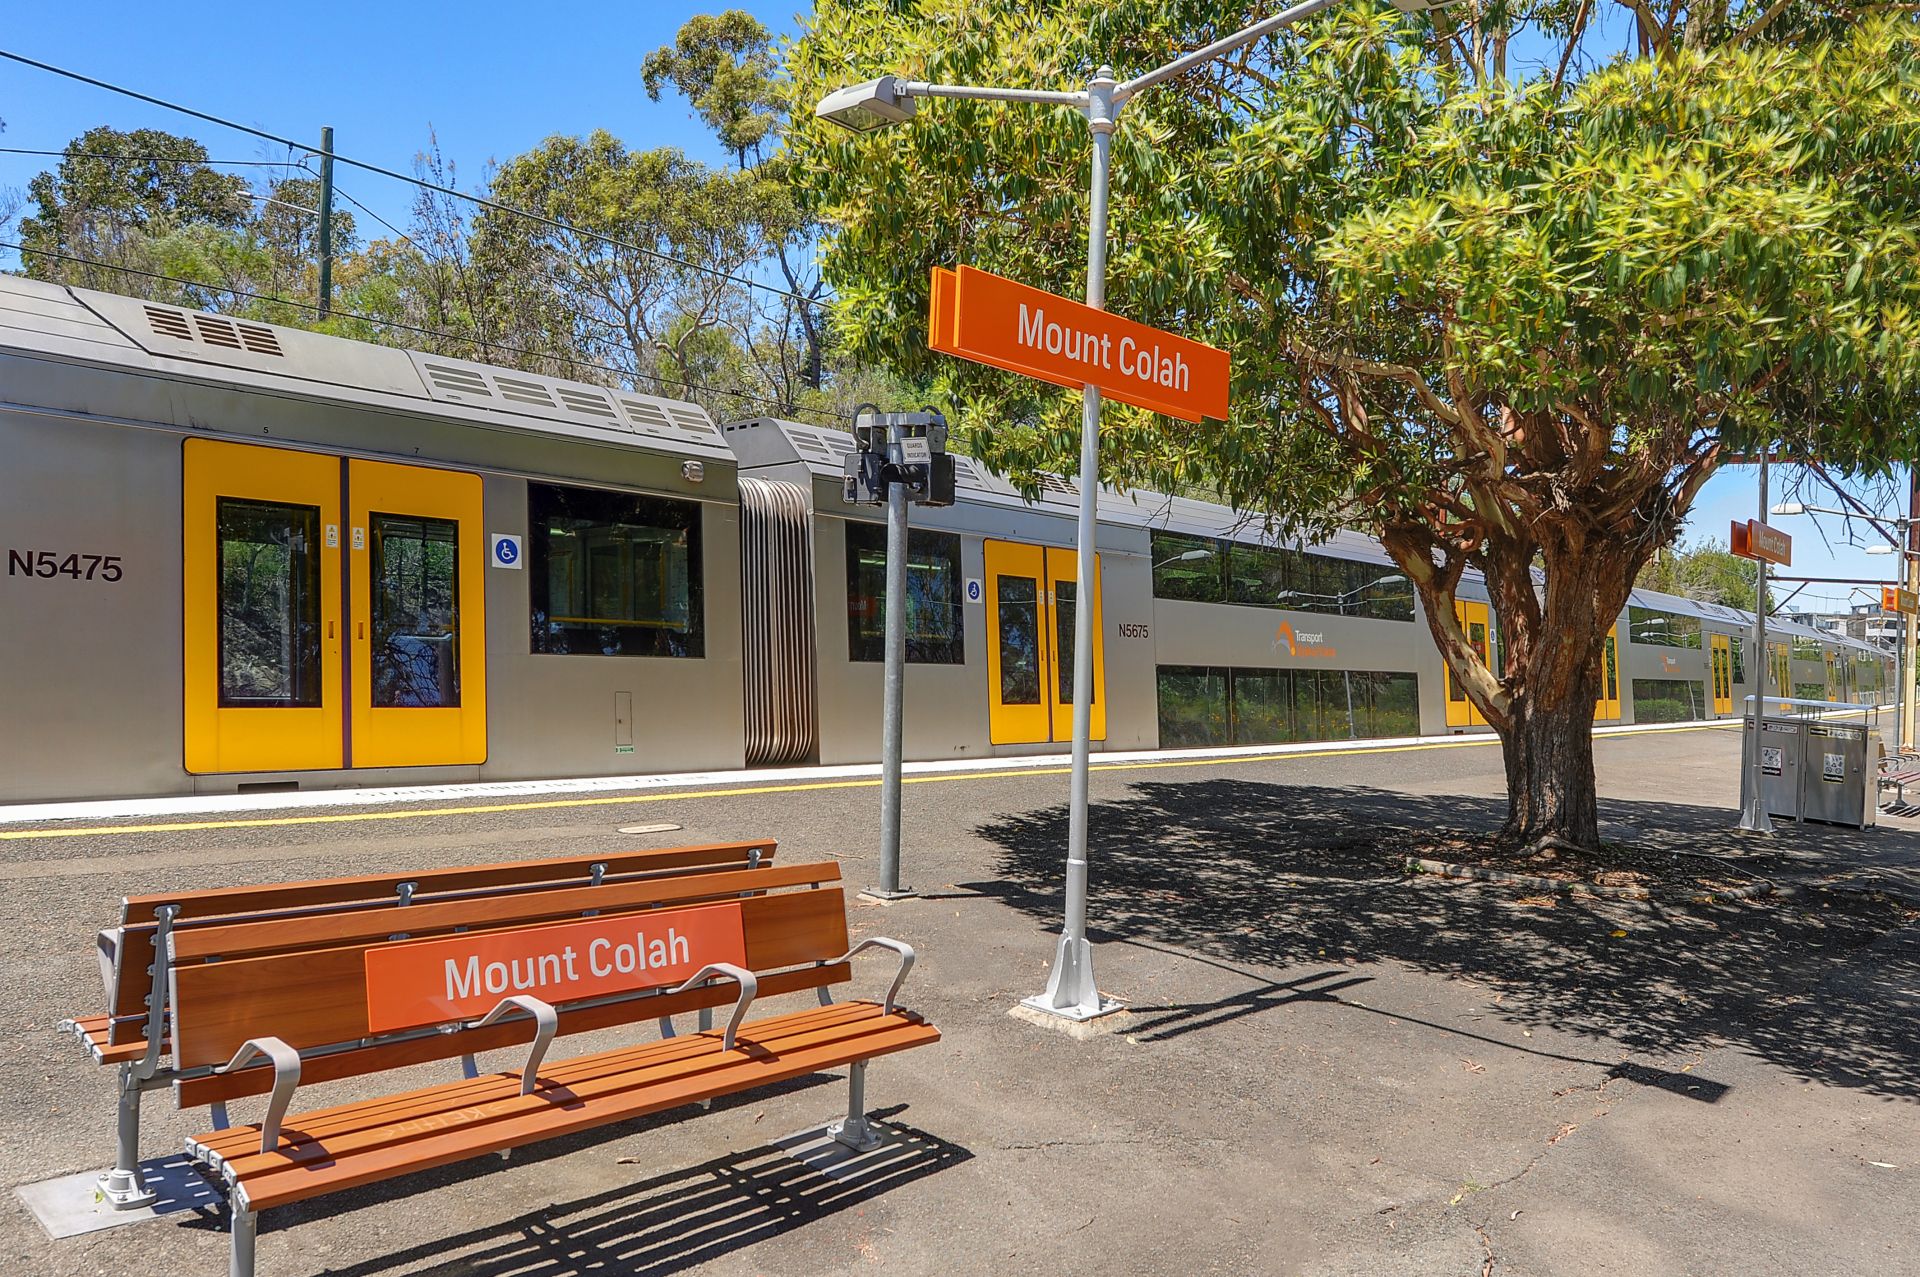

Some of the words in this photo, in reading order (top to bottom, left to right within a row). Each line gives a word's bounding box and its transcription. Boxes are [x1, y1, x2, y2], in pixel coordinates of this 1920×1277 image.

[1018, 303, 1112, 370] Mount
[1119, 336, 1190, 392] Colah
[8, 549, 123, 582] N5475
[1118, 623, 1149, 639] N5675
[1295, 630, 1323, 645] Transport
[444, 946, 580, 1001] Mount
[588, 927, 691, 978] Colah
